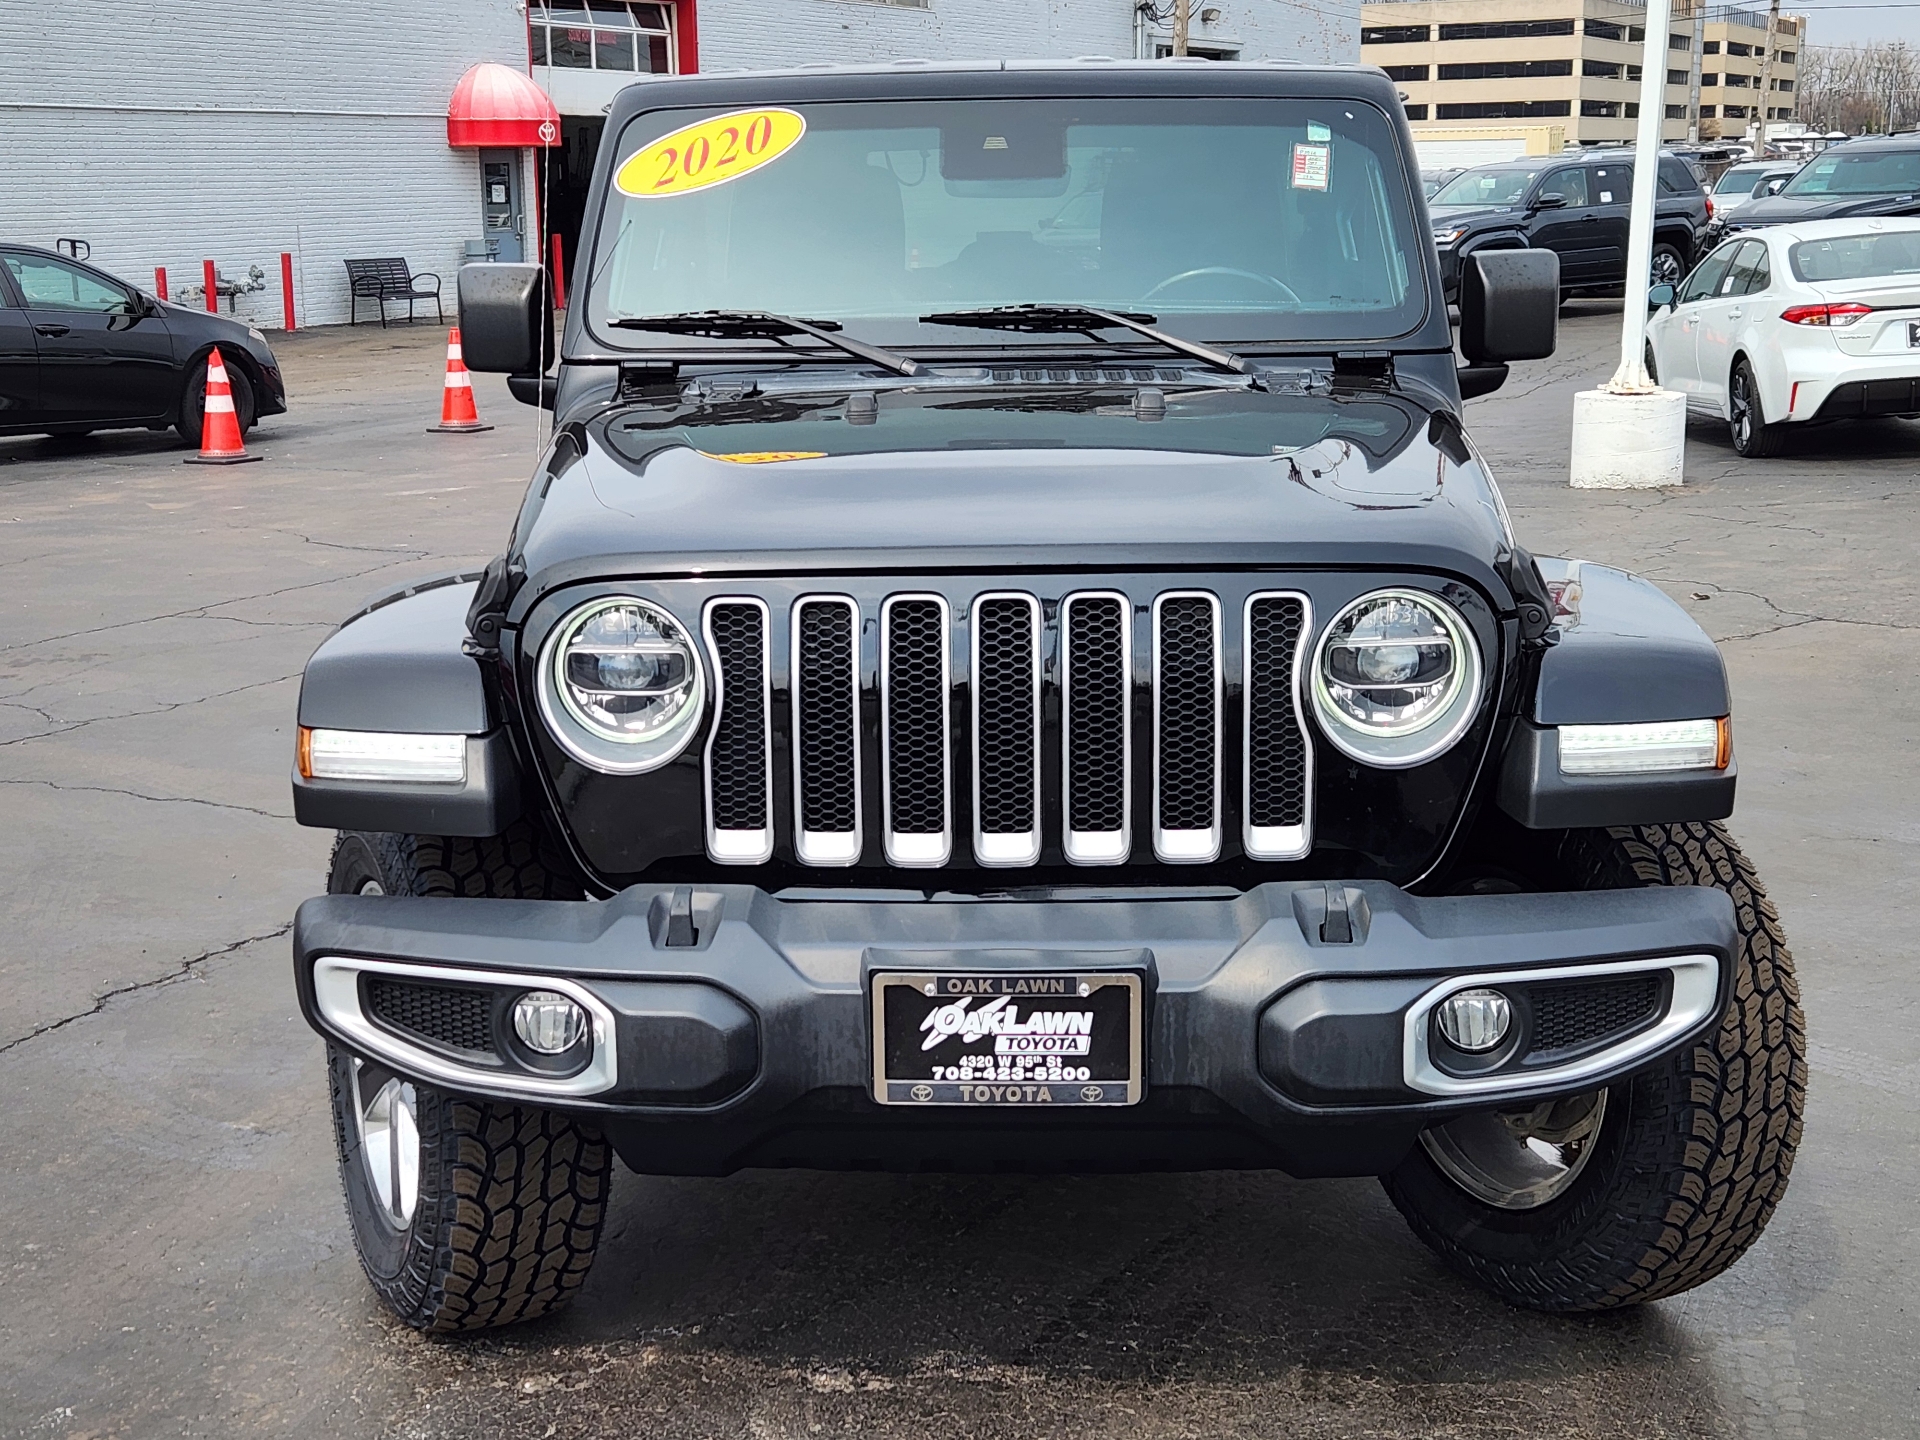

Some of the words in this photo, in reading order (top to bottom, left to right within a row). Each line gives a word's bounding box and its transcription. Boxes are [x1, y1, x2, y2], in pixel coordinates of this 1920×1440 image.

[652, 115, 772, 189] 2020
[947, 978, 994, 994] OAK
[1001, 978, 1065, 993] LAWN
[1005, 1037, 1079, 1051] TOYOTA
[959, 1056, 994, 1067] 4320
[997, 1056, 1012, 1067] W
[1016, 1055, 1042, 1067] 95th
[1046, 1055, 1063, 1068] St
[931, 1066, 1091, 1081] 708-423-5200
[959, 1086, 1052, 1102] TOYOTA
